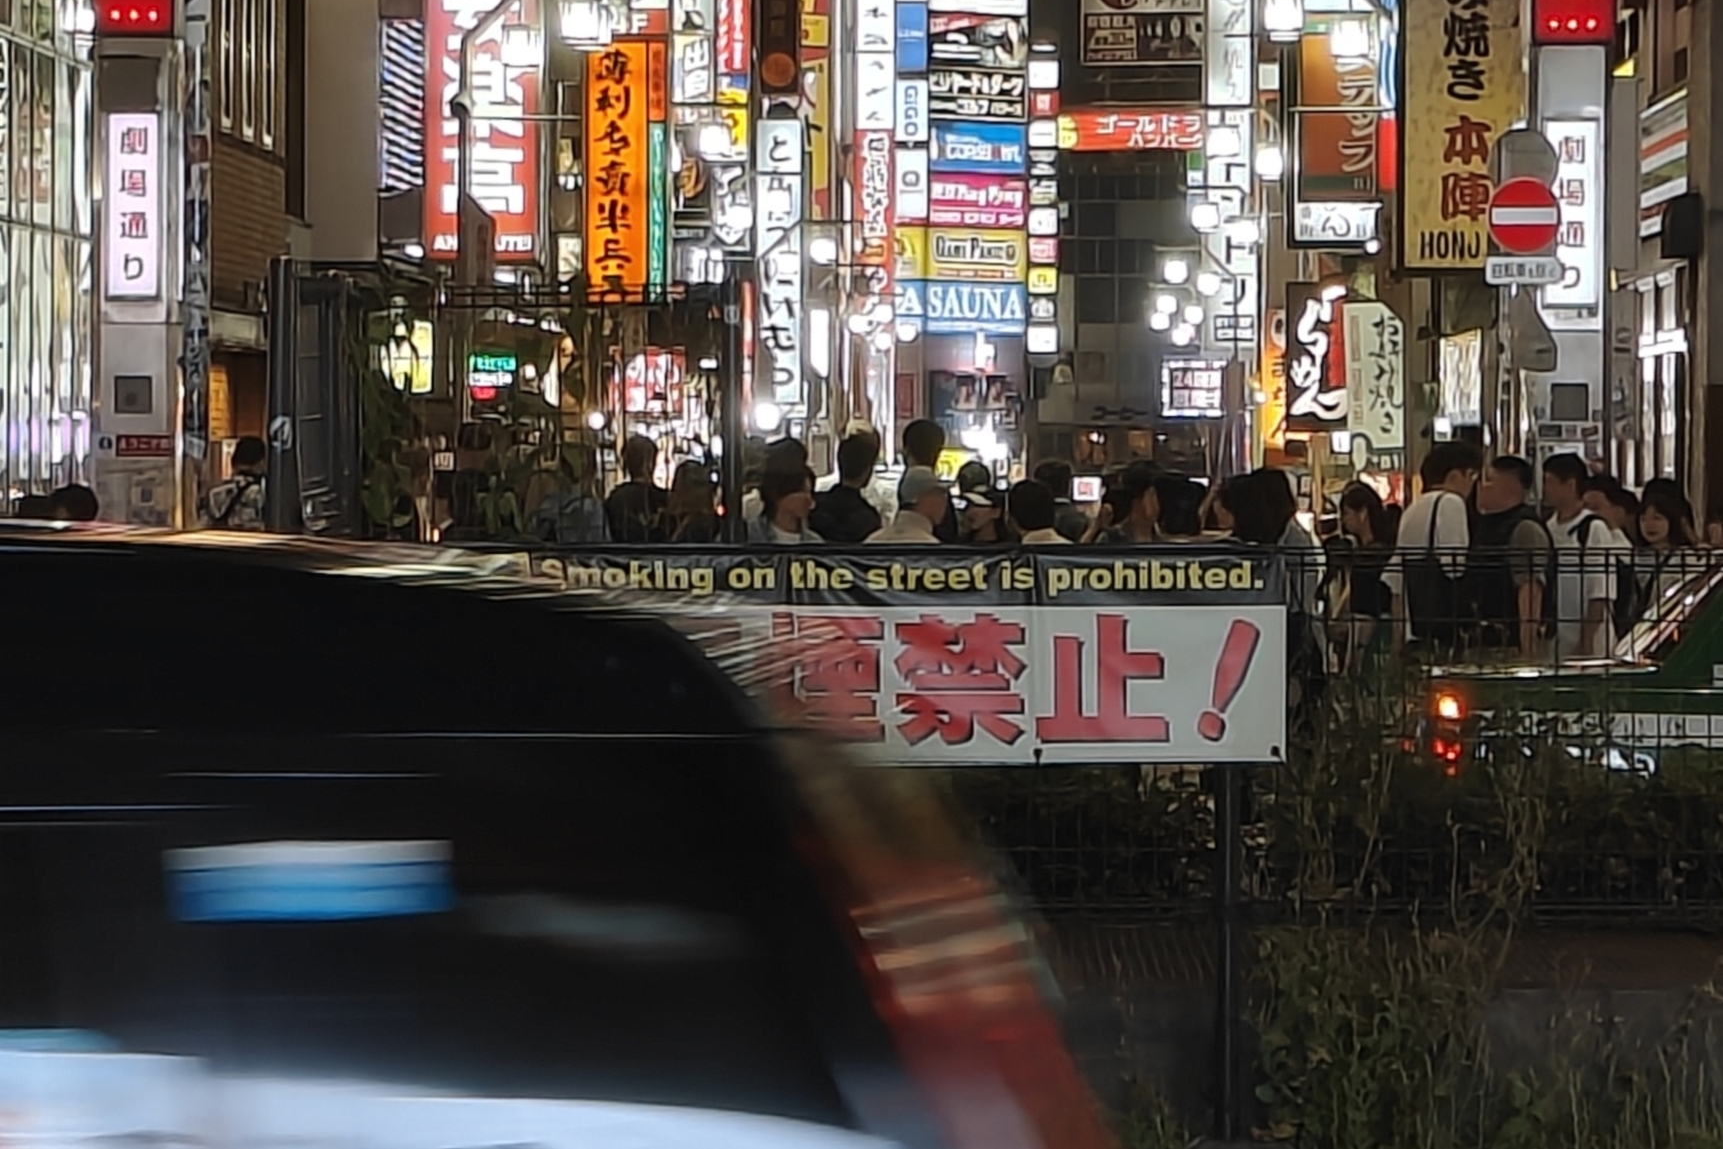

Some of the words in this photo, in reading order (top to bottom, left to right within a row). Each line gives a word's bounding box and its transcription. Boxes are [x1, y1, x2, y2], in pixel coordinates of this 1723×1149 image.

[1441, 115, 1493, 223] 本陣
[119, 126, 149, 281] 劇場通り
[1420, 231, 1490, 260] HONJ
[928, 286, 1026, 320] SAUNA
[541, 558, 715, 596] Smoking
[728, 564, 776, 590] on
[789, 559, 854, 590] the
[867, 561, 989, 591] street
[1001, 560, 1035, 591] is
[1047, 559, 1265, 597] prohibited.
